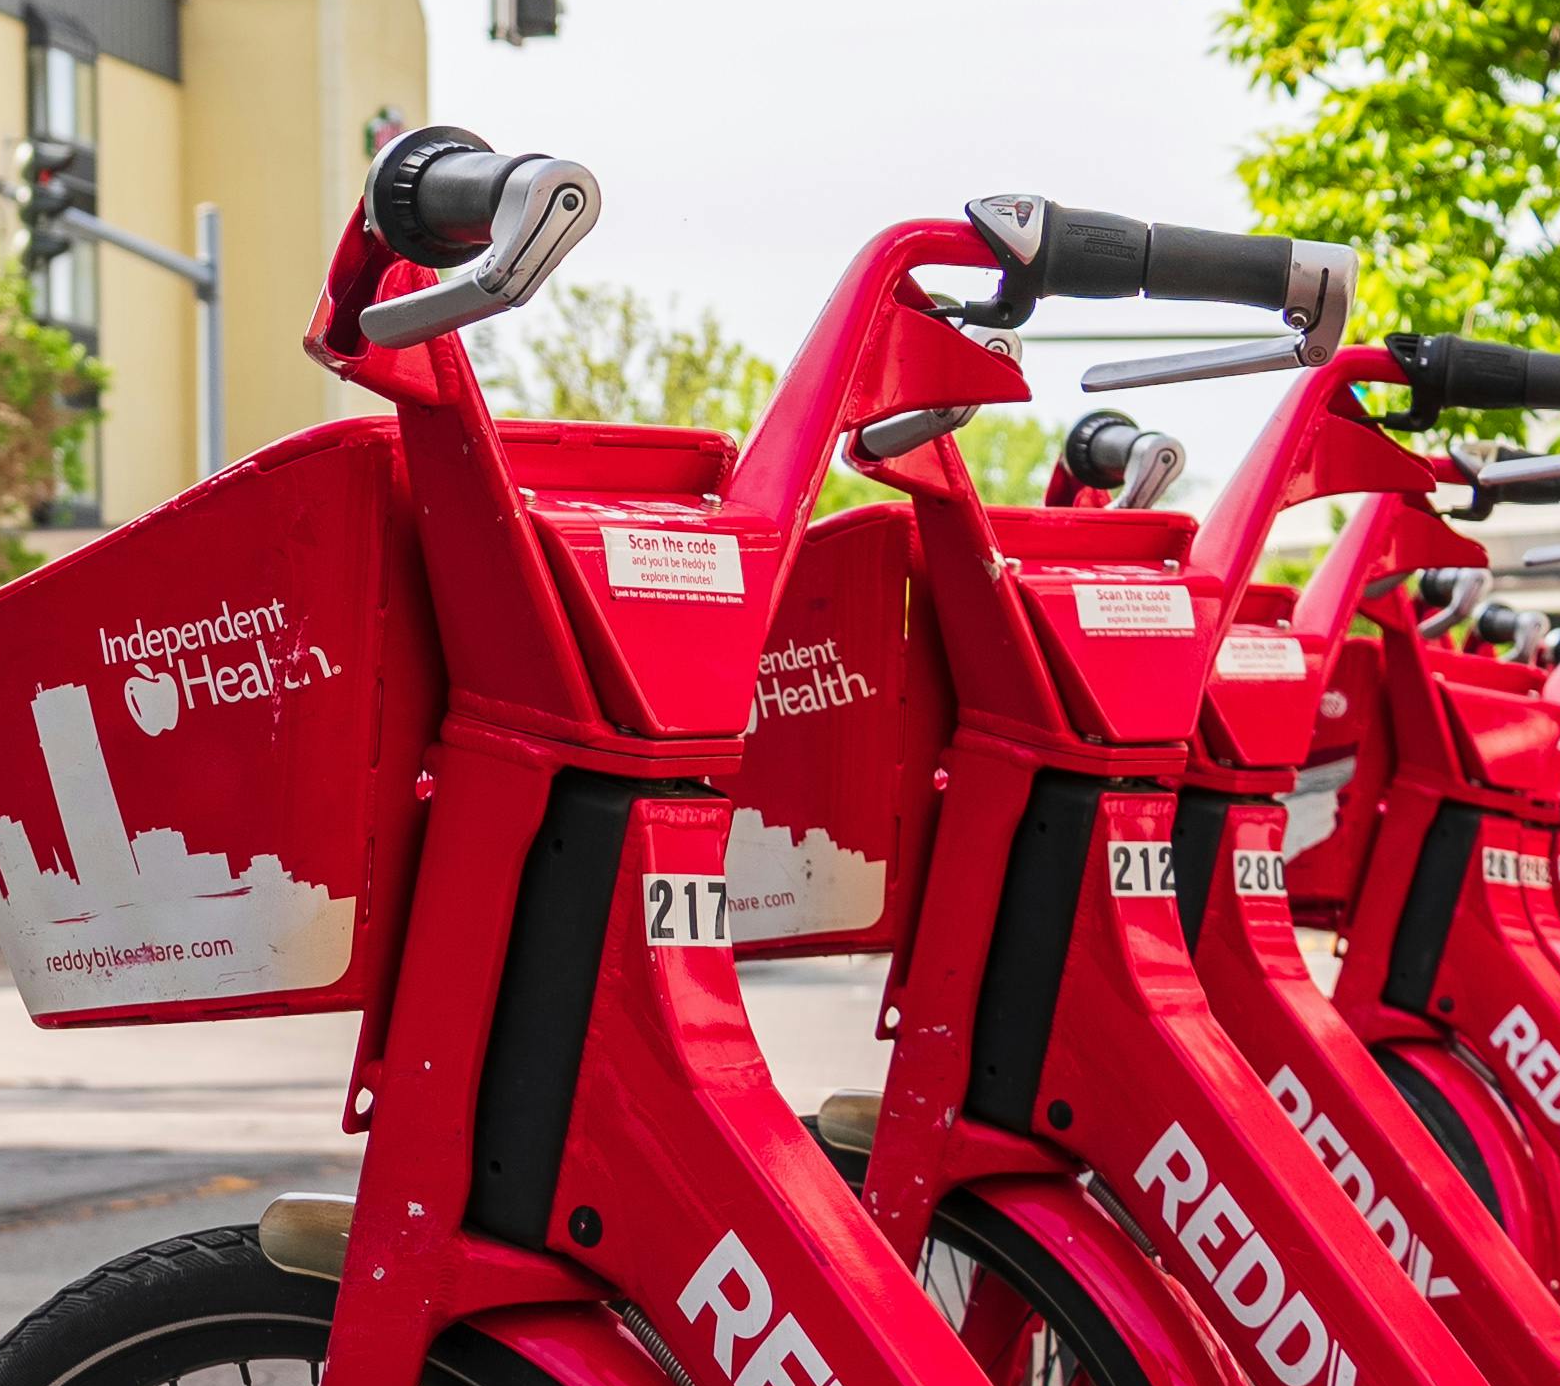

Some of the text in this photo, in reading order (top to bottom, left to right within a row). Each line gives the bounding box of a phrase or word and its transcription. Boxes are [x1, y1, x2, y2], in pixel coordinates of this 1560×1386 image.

[628, 534, 717, 555] Scan the code
[632, 555, 717, 571] and you'll be Reddy to
[641, 571, 714, 585] explore in minutes!
[615, 589, 629, 598] Look
[629, 590, 639, 598] for
[639, 590, 656, 599] Social
[1096, 588, 1171, 601] Scan the code
[98, 597, 286, 668] Independent
[758, 637, 841, 675] endent
[1113, 845, 1176, 891] 212
[1237, 854, 1286, 891] 280
[649, 878, 727, 941] 217
